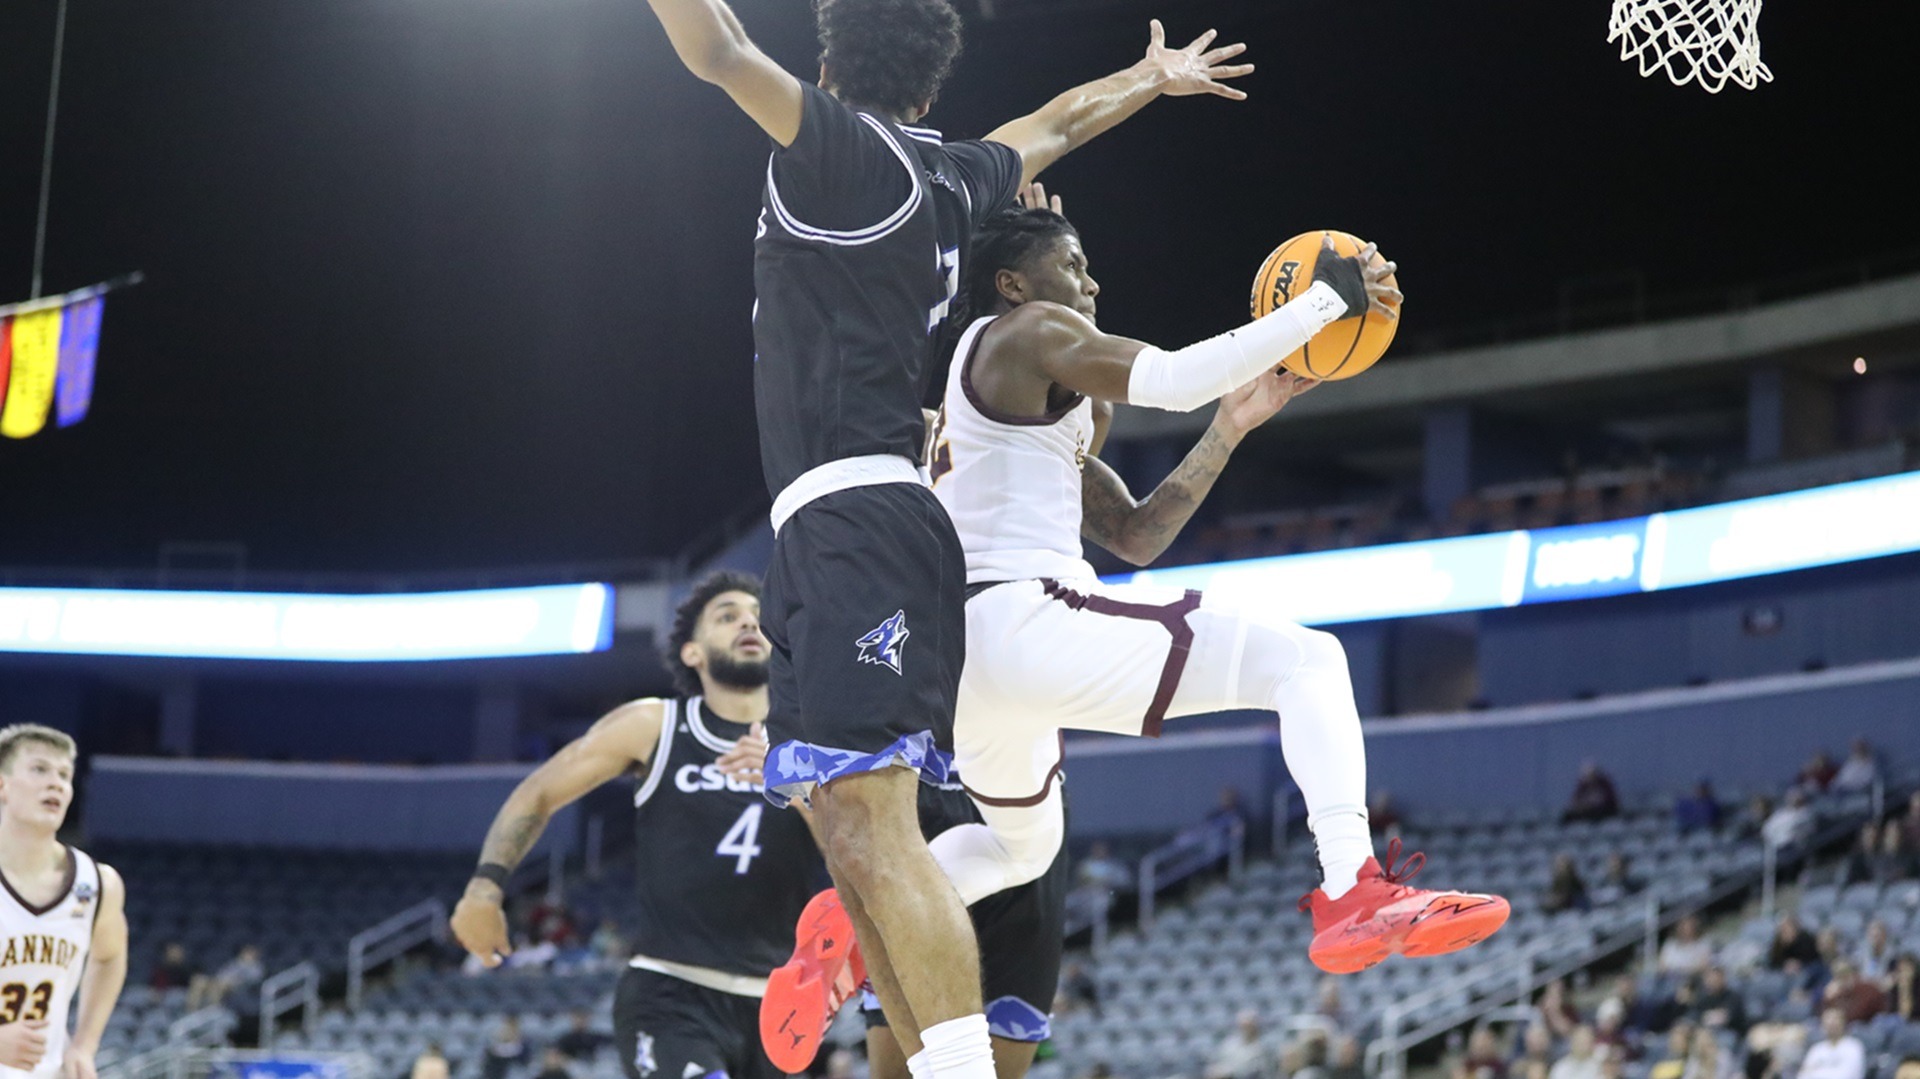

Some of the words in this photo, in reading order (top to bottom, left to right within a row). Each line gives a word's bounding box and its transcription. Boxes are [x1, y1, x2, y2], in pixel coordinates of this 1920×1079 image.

[1271, 260, 1301, 312] CAA
[715, 802, 763, 875] 4
[0, 981, 54, 1026] 33
